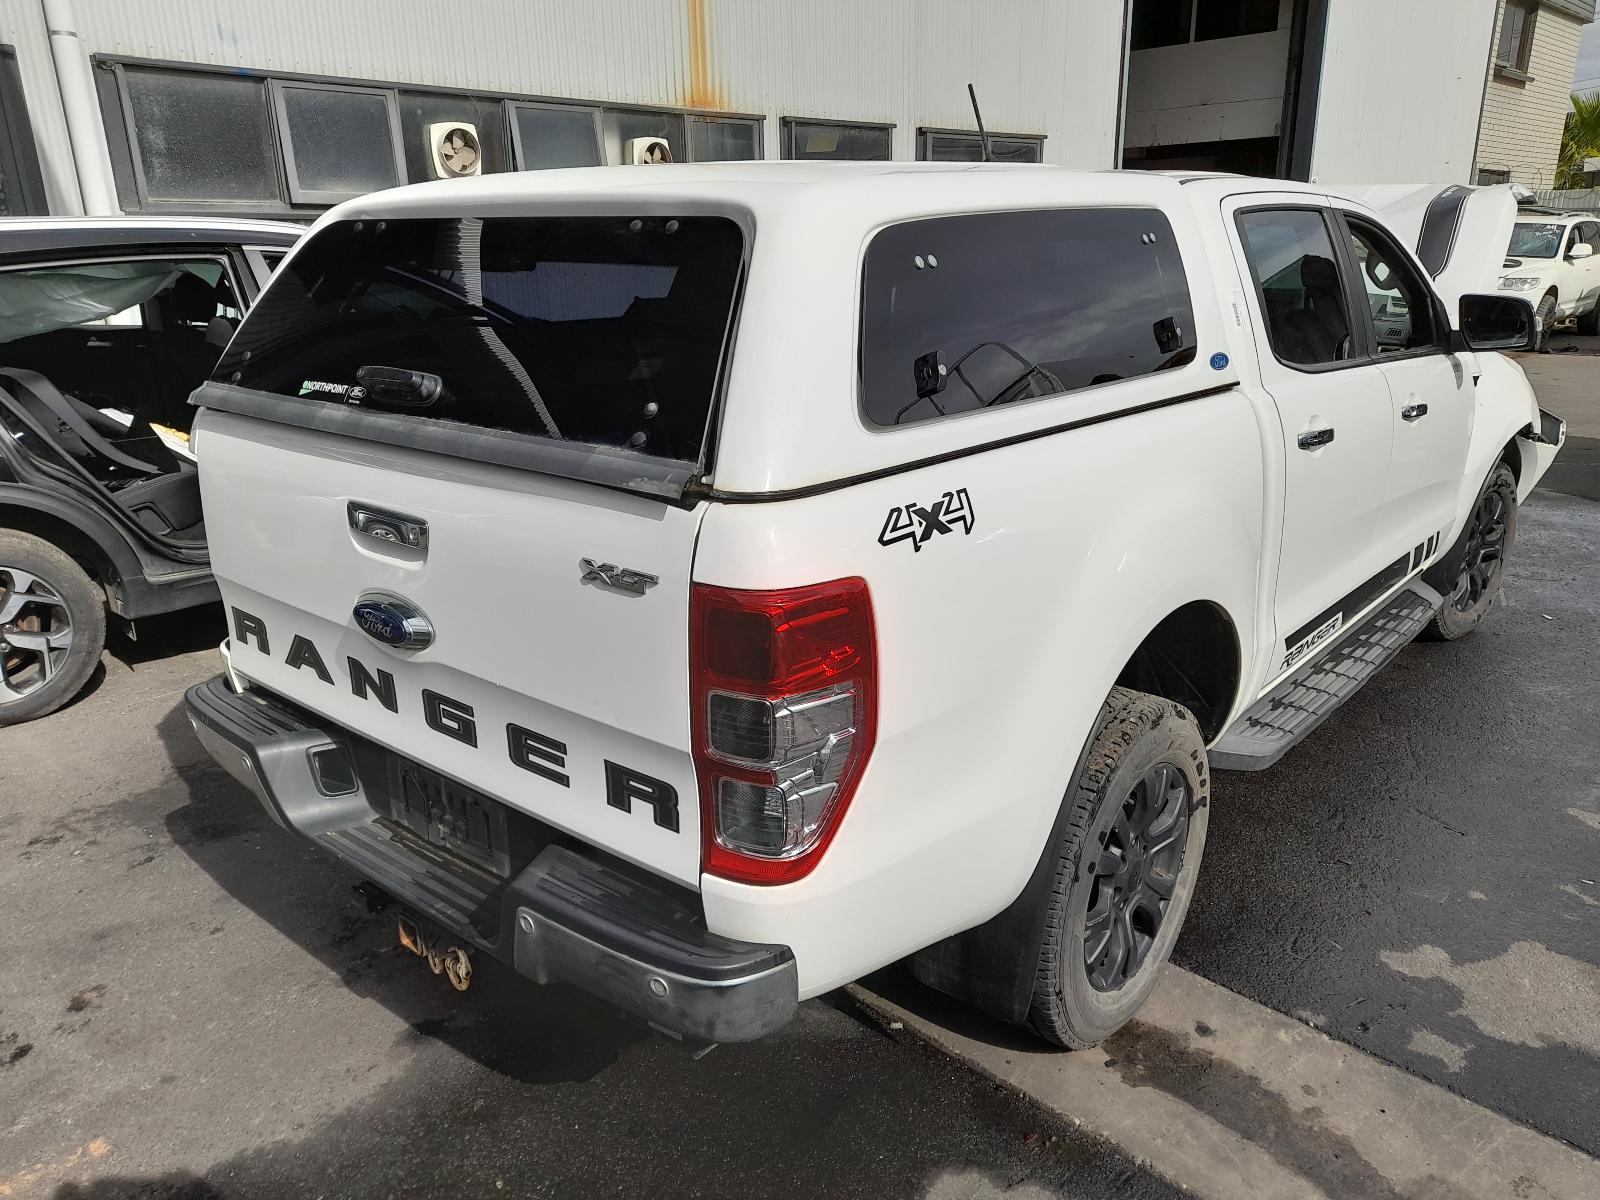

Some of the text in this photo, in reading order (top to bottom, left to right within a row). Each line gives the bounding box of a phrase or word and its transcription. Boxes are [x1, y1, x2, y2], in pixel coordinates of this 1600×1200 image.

[307, 380, 349, 395] NORTHPOINT
[360, 608, 393, 638] Ford
[1279, 616, 1340, 671] RANGER
[231, 606, 680, 834] RANGER
